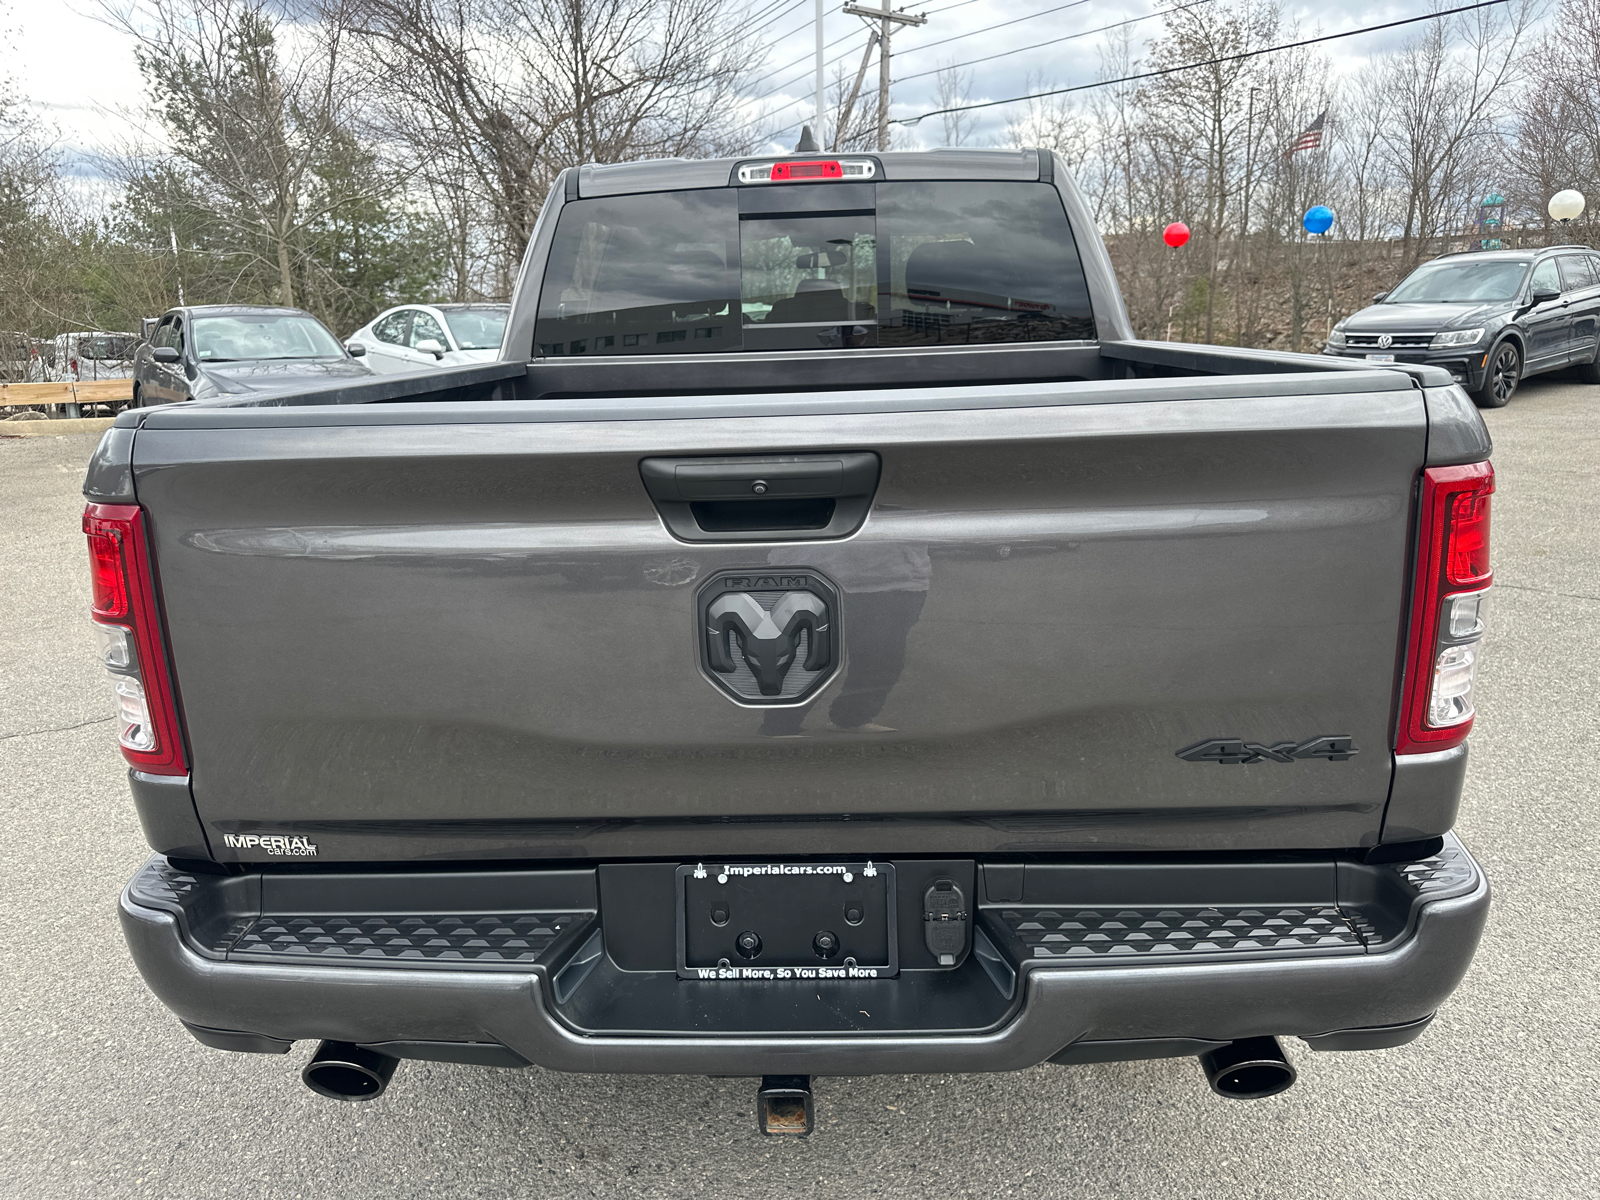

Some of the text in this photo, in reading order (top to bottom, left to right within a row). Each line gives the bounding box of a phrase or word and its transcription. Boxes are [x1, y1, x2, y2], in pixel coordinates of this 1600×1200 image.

[724, 576, 808, 588] RAM
[224, 834, 317, 849] IMPERIAL
[267, 848, 317, 856] cars.com
[724, 864, 846, 877] Imperialcars.com
[698, 968, 877, 979] We Sell More, So You Save More
